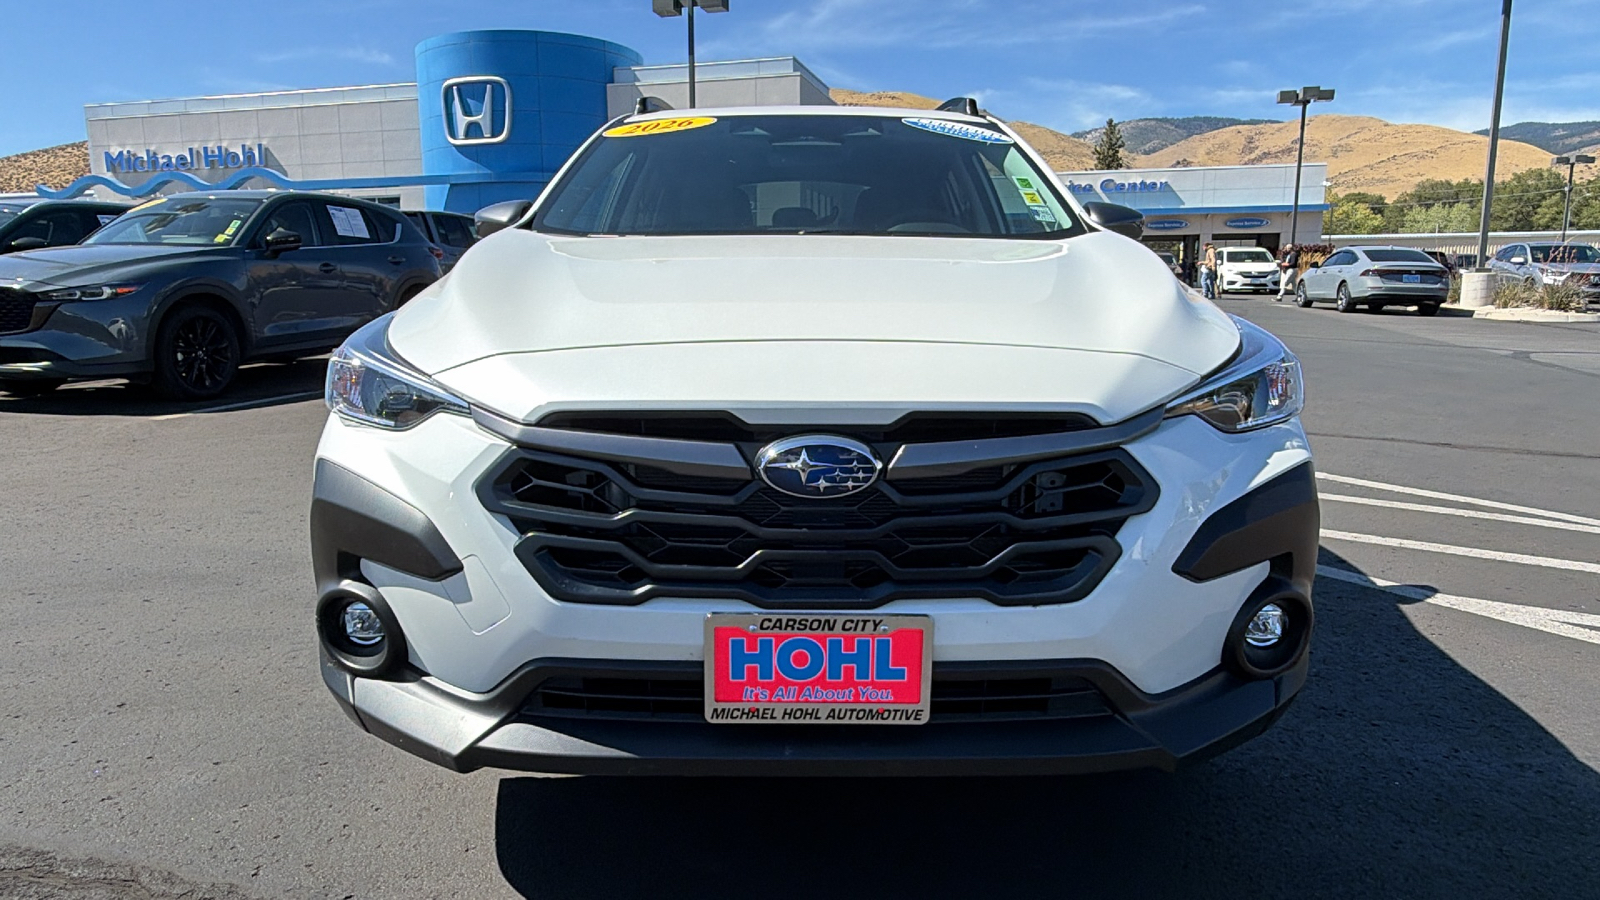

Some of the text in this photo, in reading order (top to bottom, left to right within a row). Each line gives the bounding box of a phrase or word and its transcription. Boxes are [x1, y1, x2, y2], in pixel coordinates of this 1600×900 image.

[622, 119, 694, 135] 2026
[104, 143, 265, 173] Michael Hohl
[1065, 178, 1168, 193] ice Center
[759, 617, 883, 632] CARSON CITY
[729, 636, 907, 682] HOHL
[743, 686, 894, 701] It's All About You.
[710, 707, 924, 721] MICHAEL HOHL AUTOMOTIVE
